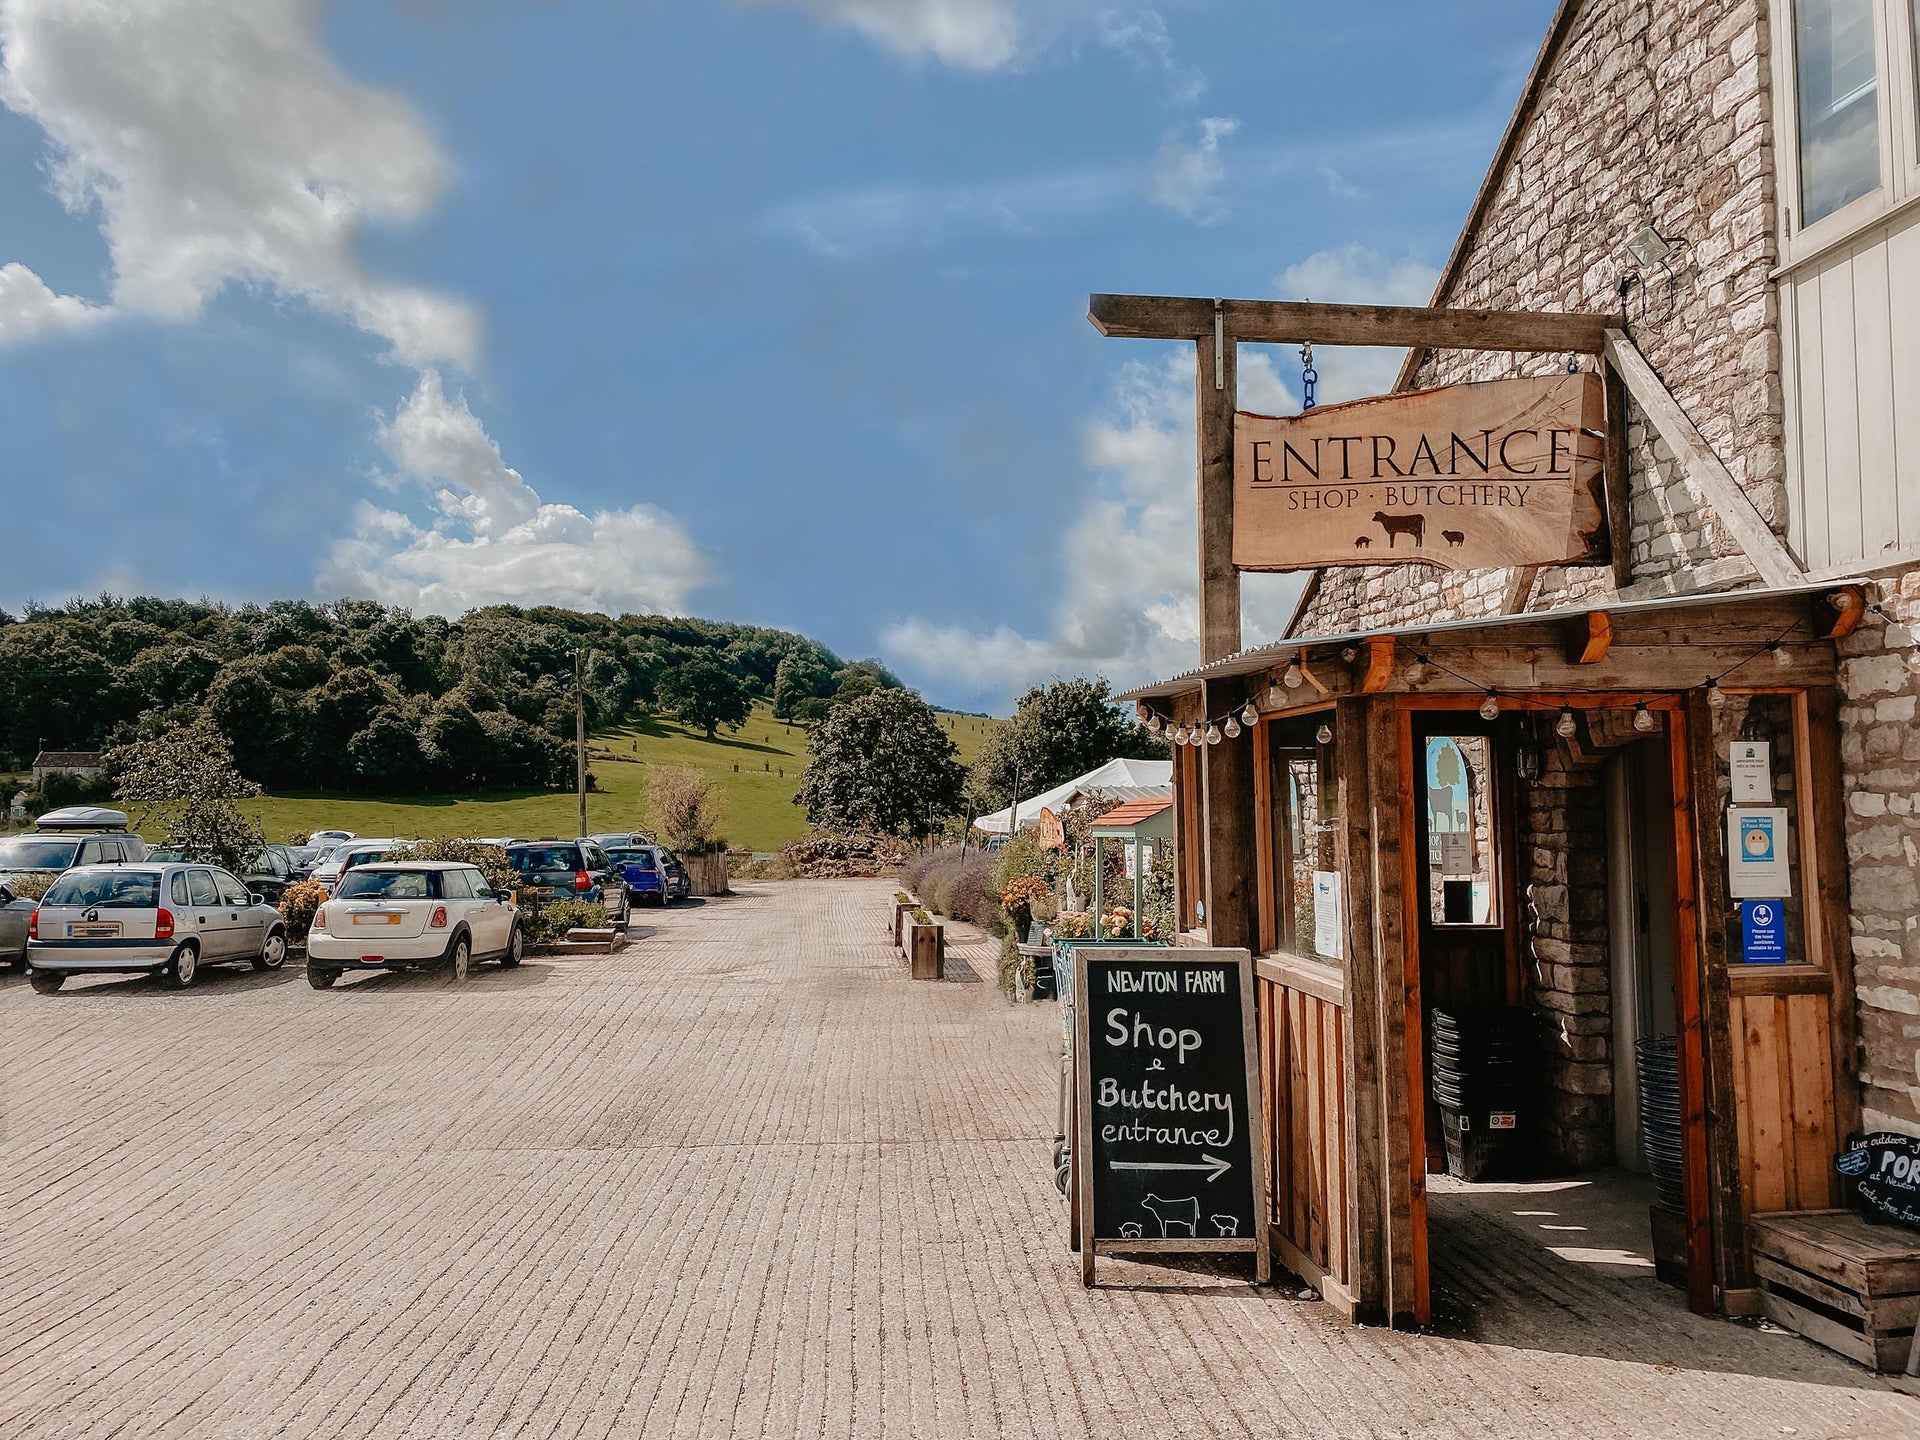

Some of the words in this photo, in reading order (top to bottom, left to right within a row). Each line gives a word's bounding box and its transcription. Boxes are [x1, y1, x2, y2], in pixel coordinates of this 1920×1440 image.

[1251, 429, 1572, 483] ENTRANCE
[1288, 488, 1359, 511] SHOP
[1385, 485, 1531, 508] BUTCHERY
[1107, 970, 1177, 993] NEWTON
[1185, 970, 1226, 993] FARM
[1105, 1007, 1203, 1065] Shop
[1097, 1077, 1234, 1147] Butchery
[1101, 1118, 1220, 1146] entrance
[1851, 1139, 1868, 1151] Live
[1870, 1134, 1907, 1147] outdoors
[1869, 1171, 1881, 1181] at
[1885, 1175, 1916, 1191] Newton
